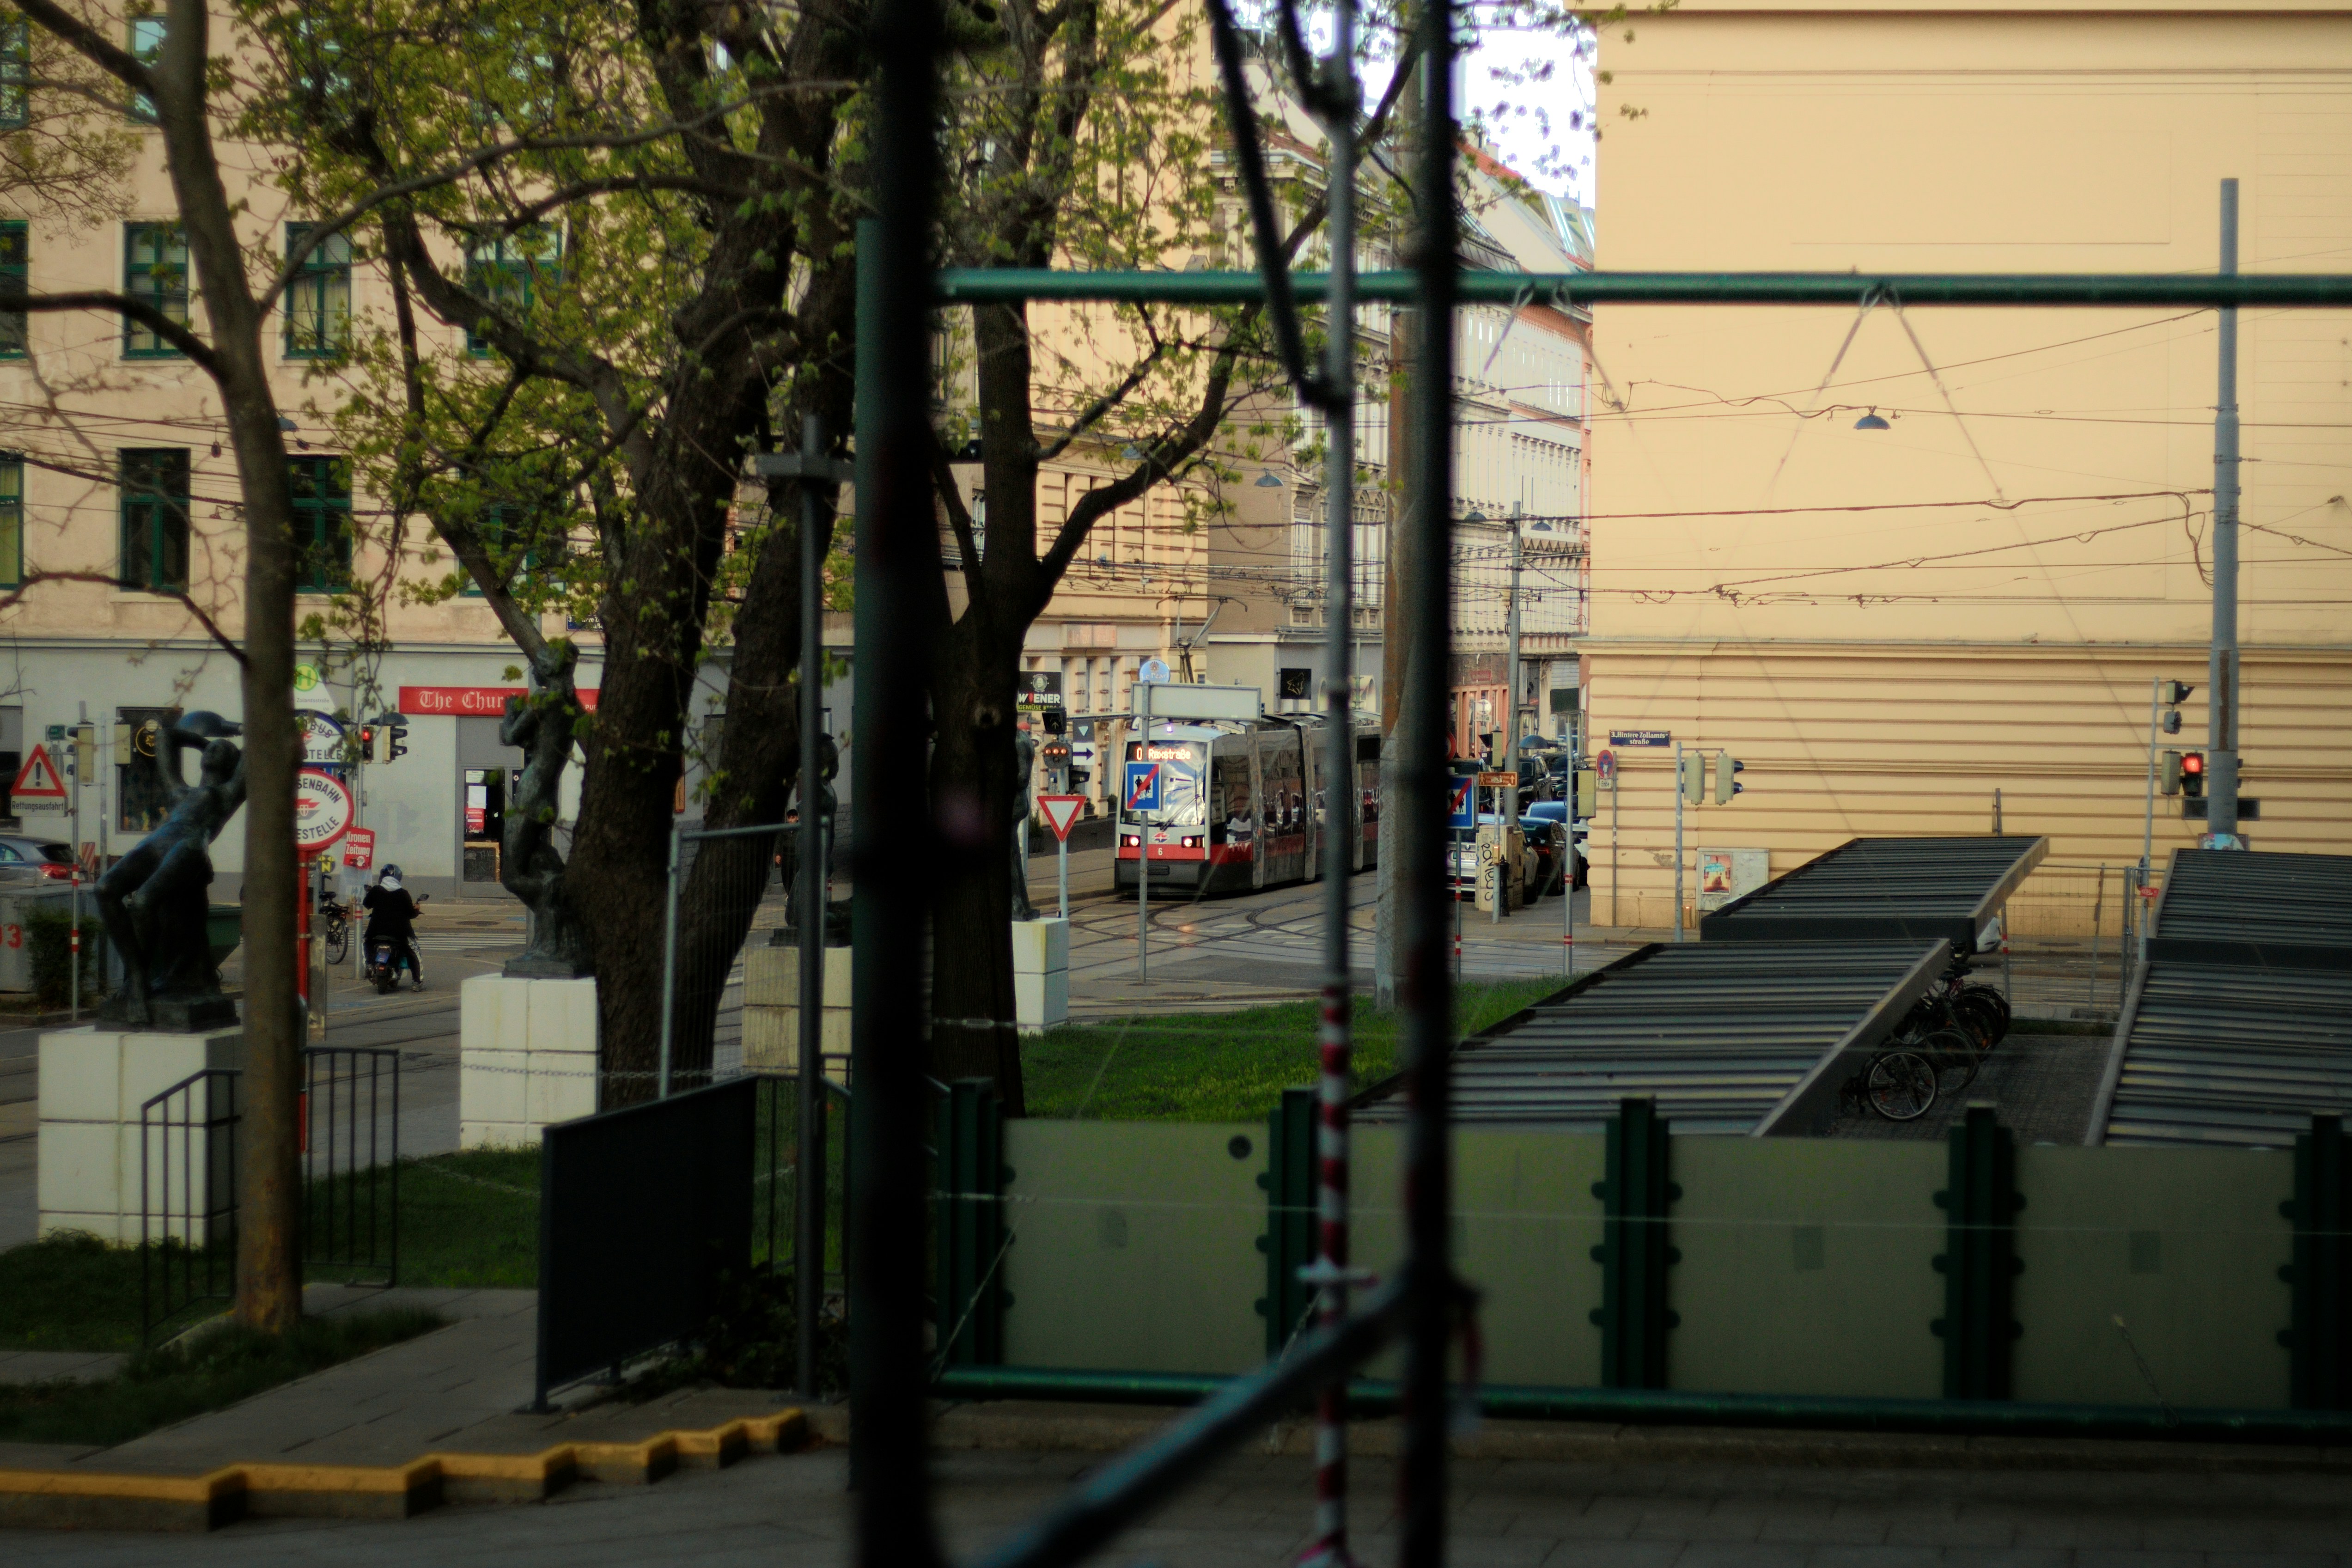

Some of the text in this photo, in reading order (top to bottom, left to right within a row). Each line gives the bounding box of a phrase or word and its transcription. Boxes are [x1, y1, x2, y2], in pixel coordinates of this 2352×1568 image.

[418, 690, 516, 712] The Chur
[1148, 748, 1191, 760] Raxstraße
[297, 777, 341, 804] SENBAHN
[12, 801, 63, 812] Rettungsausfahrt
[297, 816, 340, 840] ESTELLE
[347, 831, 370, 843] Kronen
[346, 844, 370, 857] Zeitung
[1158, 848, 1163, 856] 6
[0, 924, 22, 949] 3
